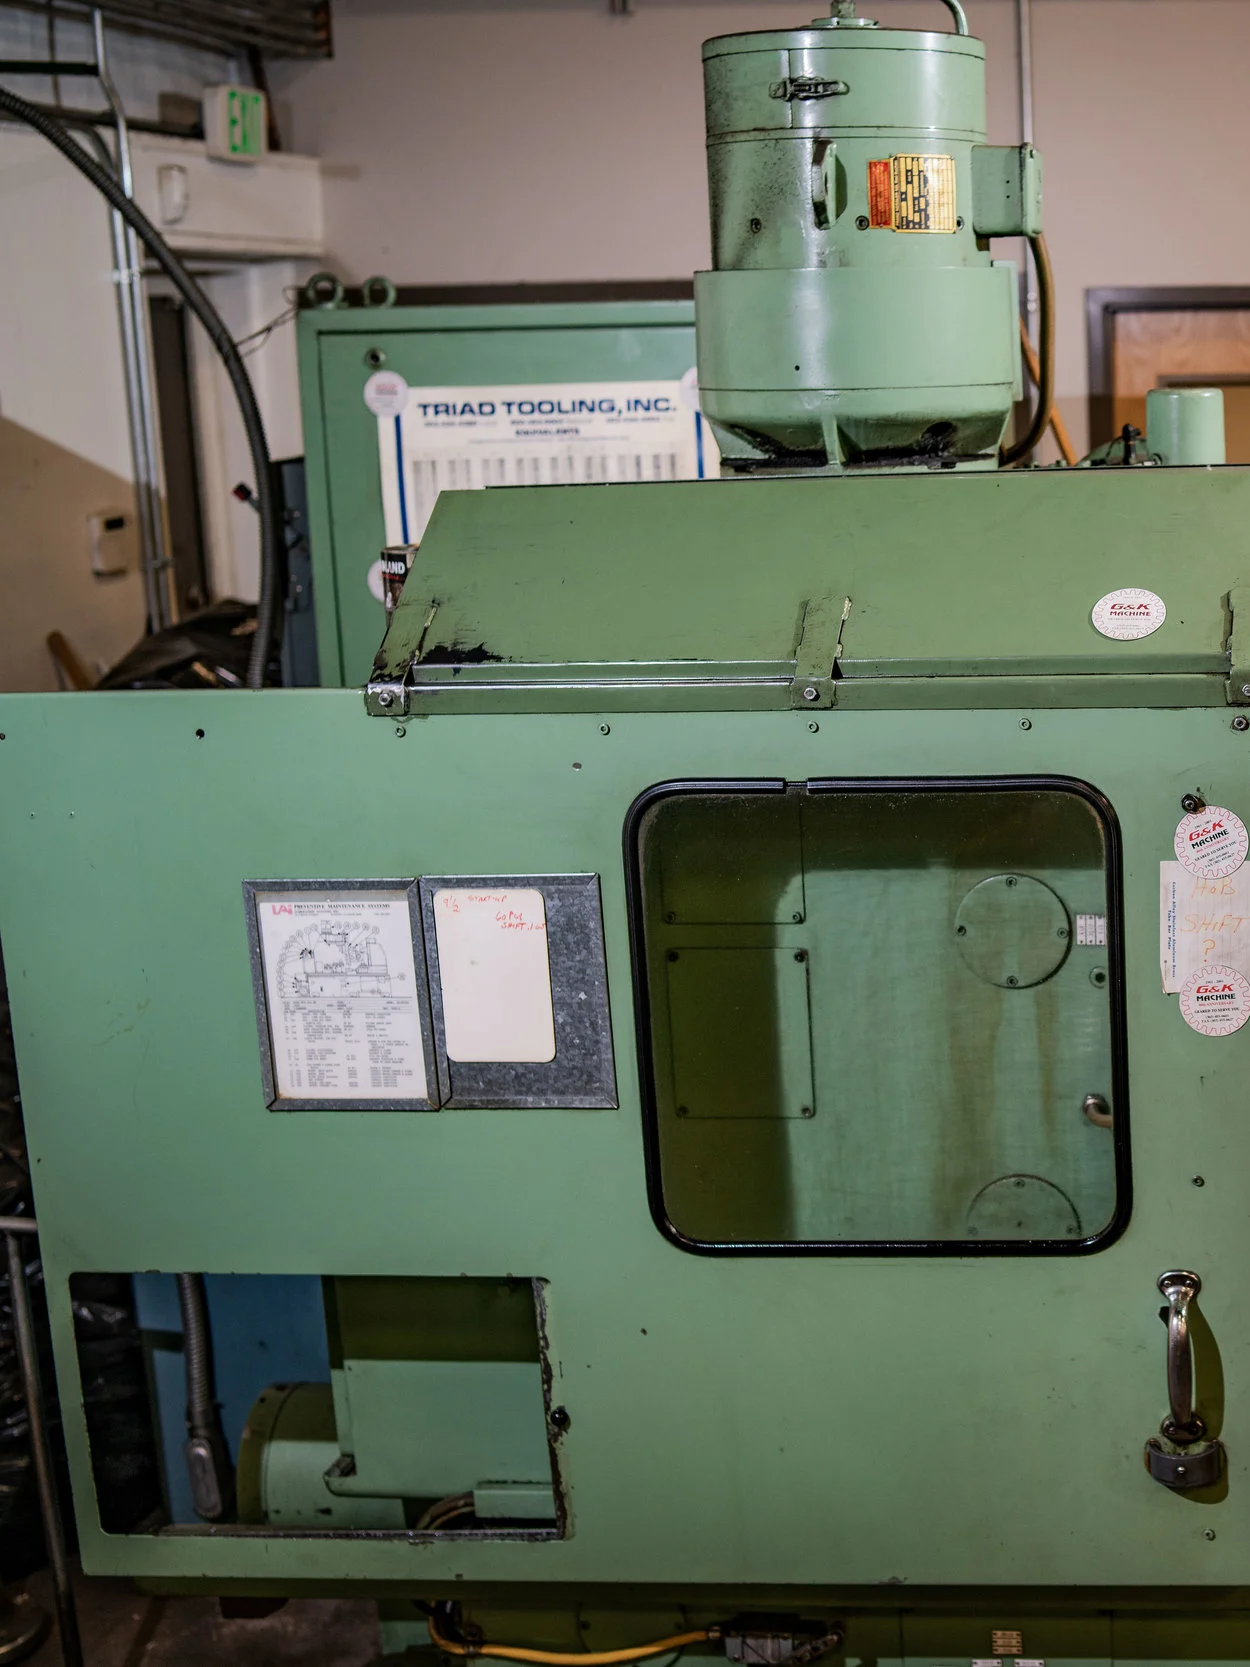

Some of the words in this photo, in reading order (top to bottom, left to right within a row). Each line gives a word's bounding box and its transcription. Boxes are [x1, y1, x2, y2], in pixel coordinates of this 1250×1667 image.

[417, 402, 496, 416] TRIAD
[501, 400, 622, 417] TOOLING,
[626, 397, 677, 412] INC.
[1189, 819, 1224, 841] G&K
[1191, 829, 1230, 850] MACHINE
[1203, 939, 1216, 962] ?
[1196, 984, 1234, 994] G&K
[1196, 994, 1236, 1002] MACHINE
